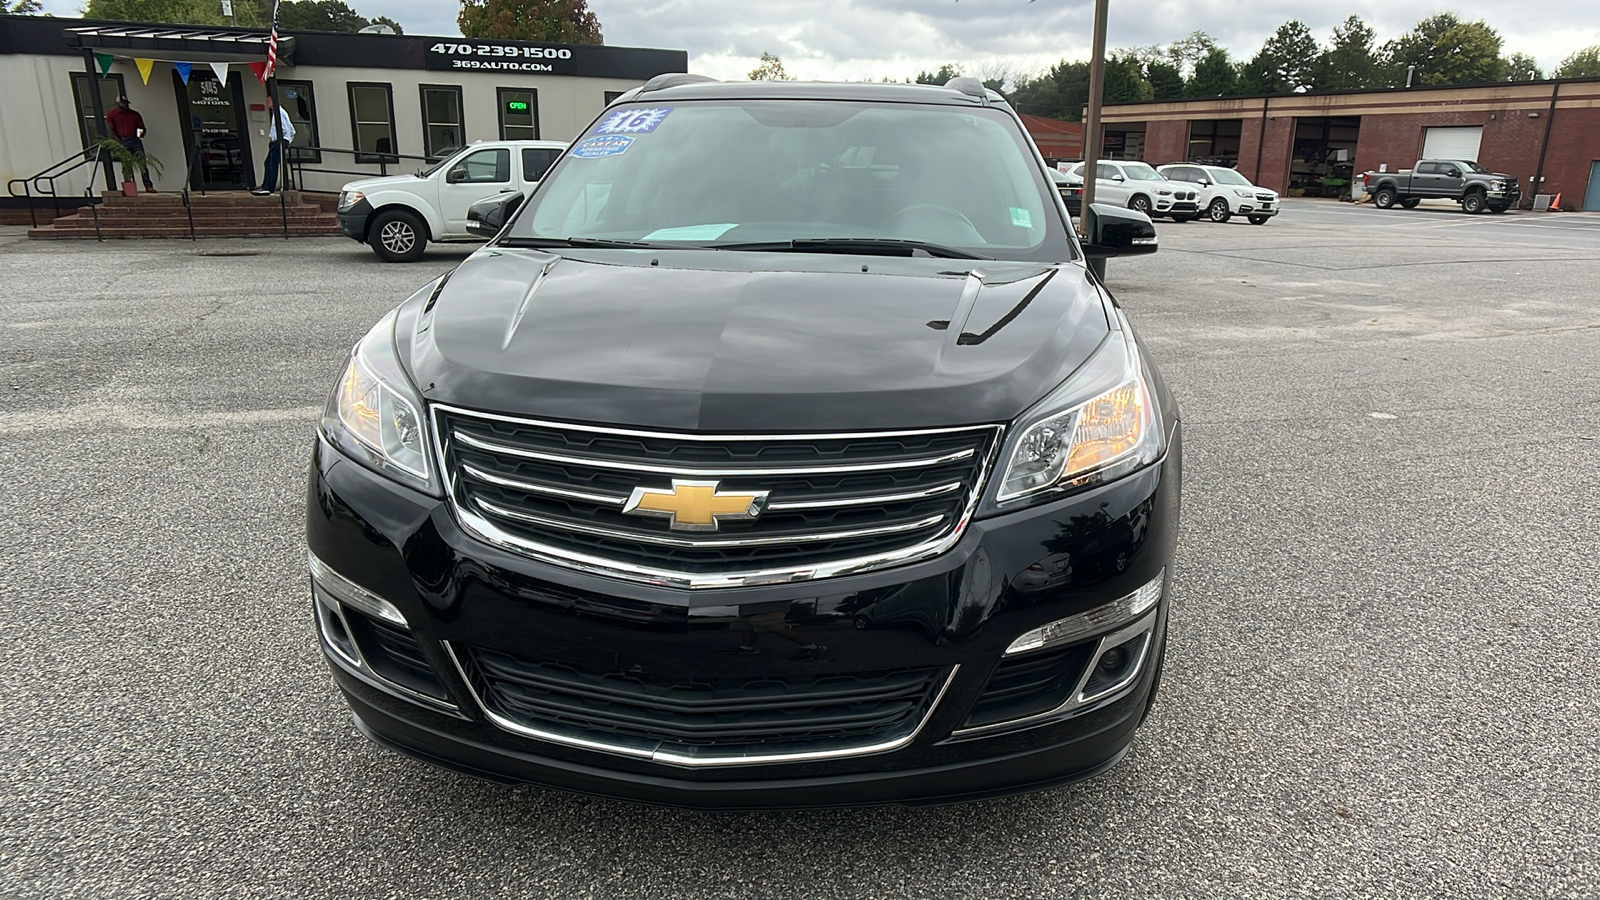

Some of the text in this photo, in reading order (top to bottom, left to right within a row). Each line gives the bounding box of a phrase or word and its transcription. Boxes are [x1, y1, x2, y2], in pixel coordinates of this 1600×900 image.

[430, 43, 572, 60] 470-239-1500
[452, 60, 552, 72] 369AUTO.COM
[613, 112, 652, 129] 16
